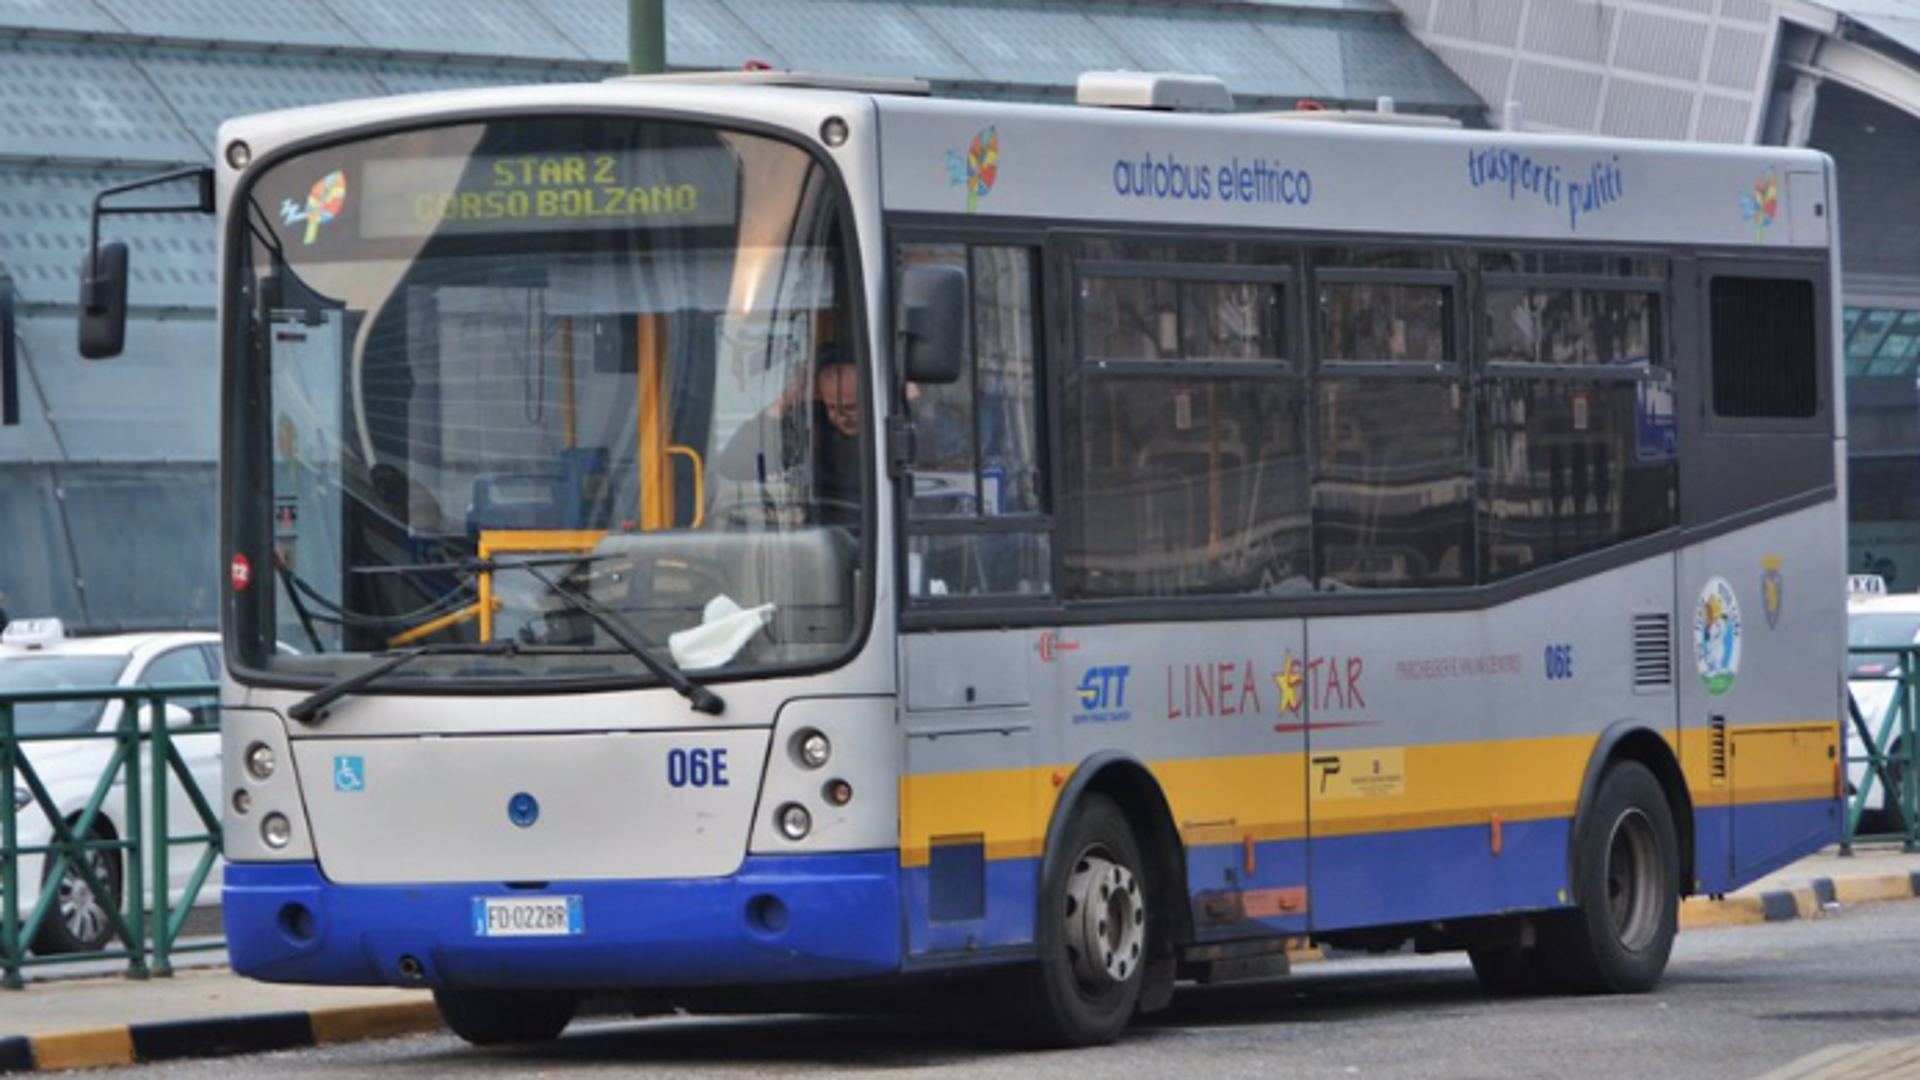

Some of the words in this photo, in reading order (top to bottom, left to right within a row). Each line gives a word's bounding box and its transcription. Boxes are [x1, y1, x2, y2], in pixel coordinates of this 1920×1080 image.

[493, 157, 587, 187] STAR
[594, 156, 617, 184] 2
[1113, 152, 1211, 200] autobus
[1217, 156, 1312, 205] elettrico
[413, 189, 529, 222] CORSO
[535, 184, 698, 218] BOLZANO
[1545, 645, 1573, 680] 06E
[1167, 658, 1261, 719] LINEA
[667, 747, 731, 788] 06E
